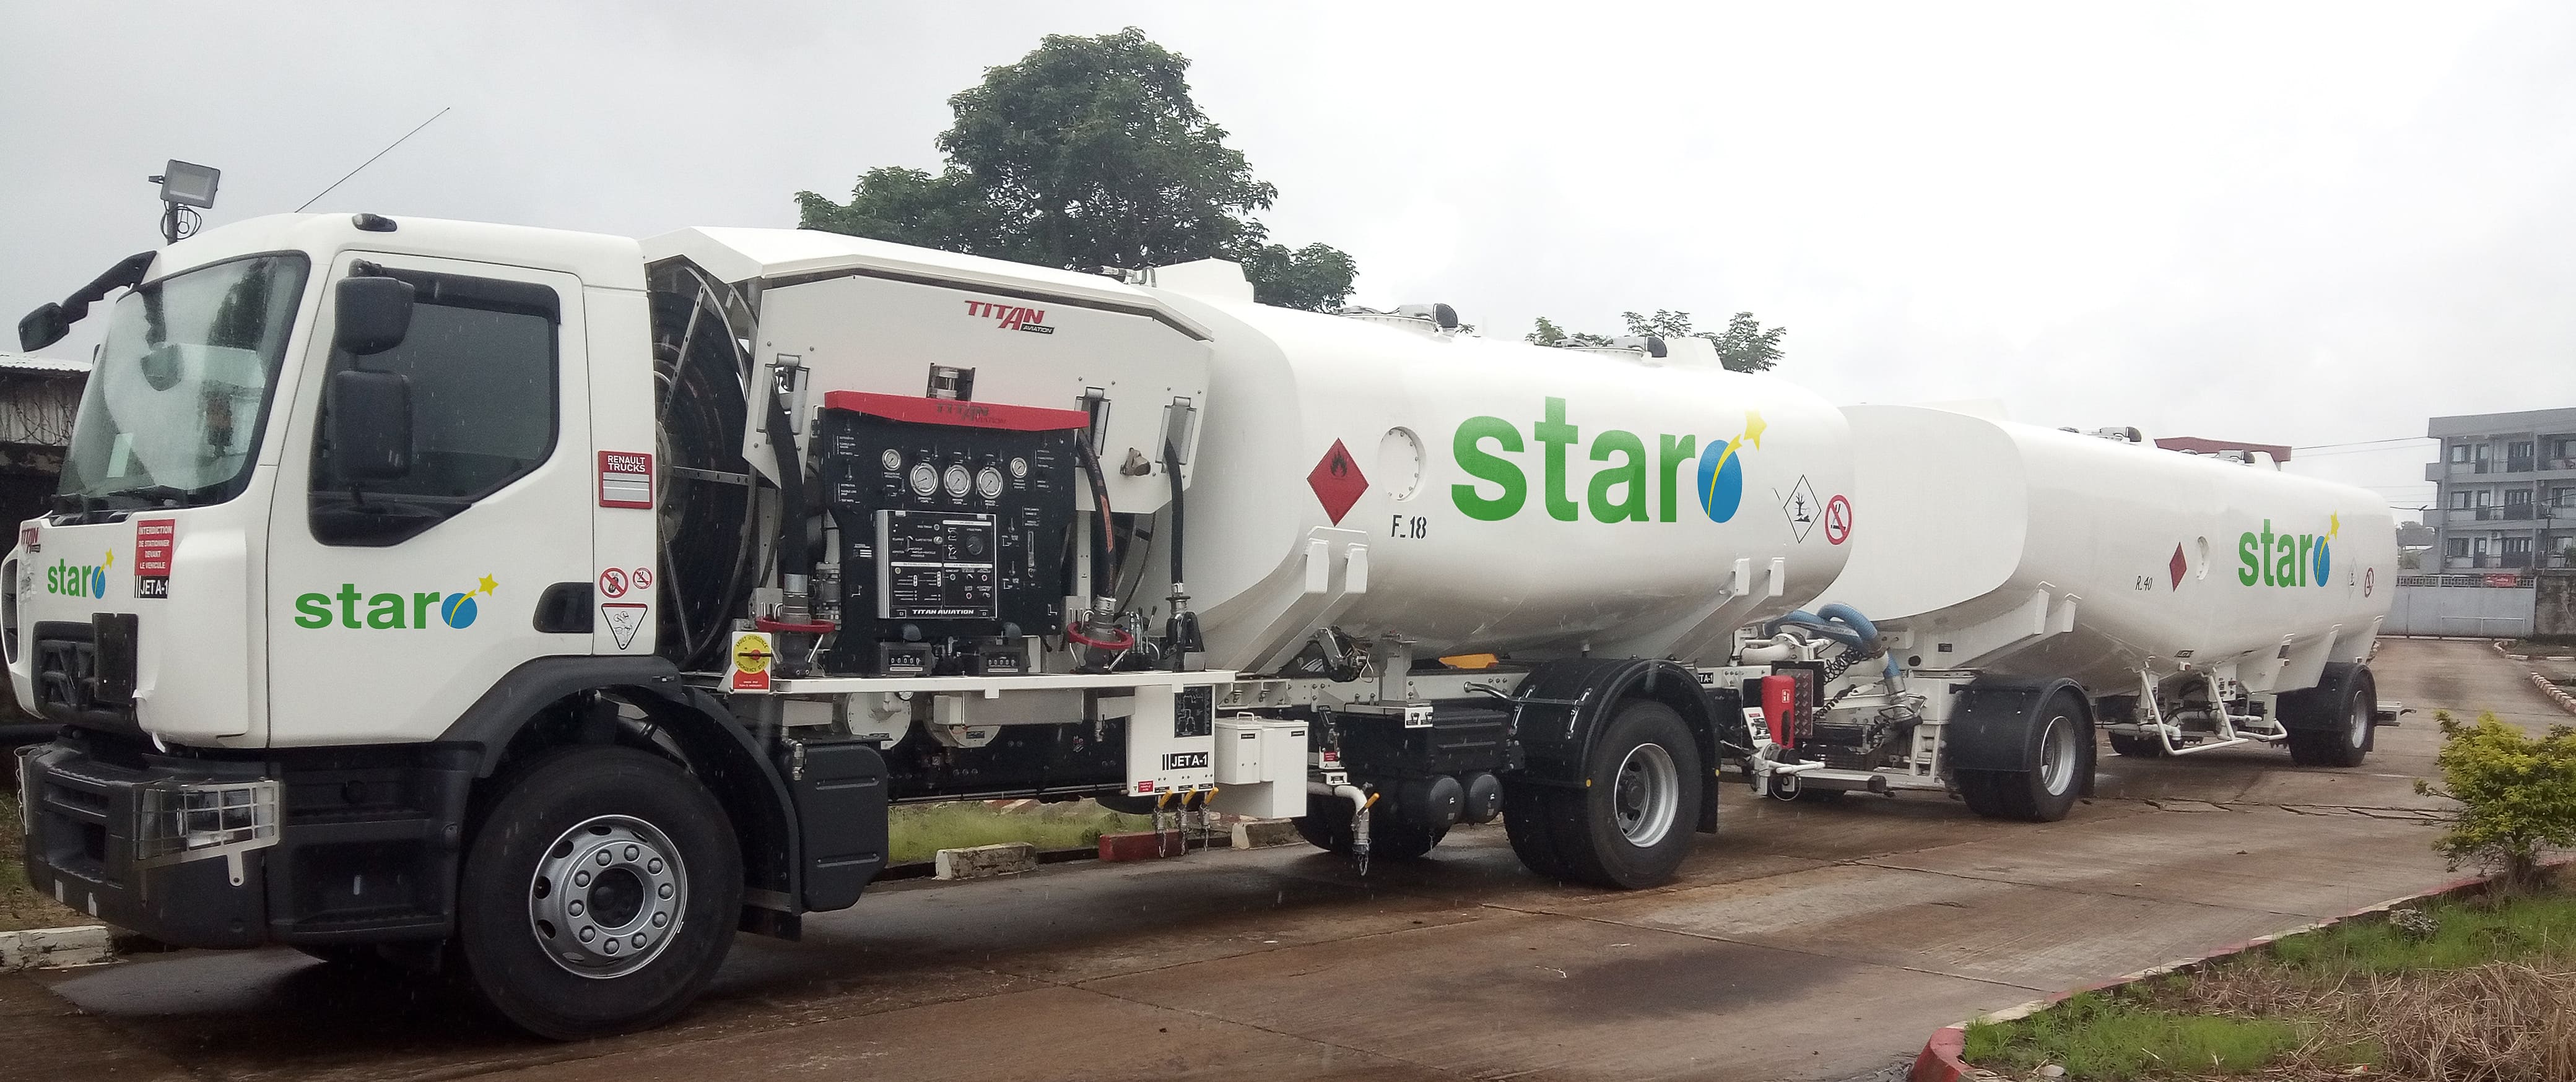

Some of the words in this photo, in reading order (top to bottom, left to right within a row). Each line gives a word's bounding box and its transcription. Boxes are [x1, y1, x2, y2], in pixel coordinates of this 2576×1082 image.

[964, 300, 1045, 331] TITAN
[1023, 325, 1053, 334] AVIATION
[607, 455, 645, 465] RENAULT
[607, 463, 645, 472] TRUCKS
[140, 579, 155, 595] JET
[155, 579, 168, 595] A-1
[1172, 755, 1191, 768] JET
[1191, 754, 1207, 766] A-1
